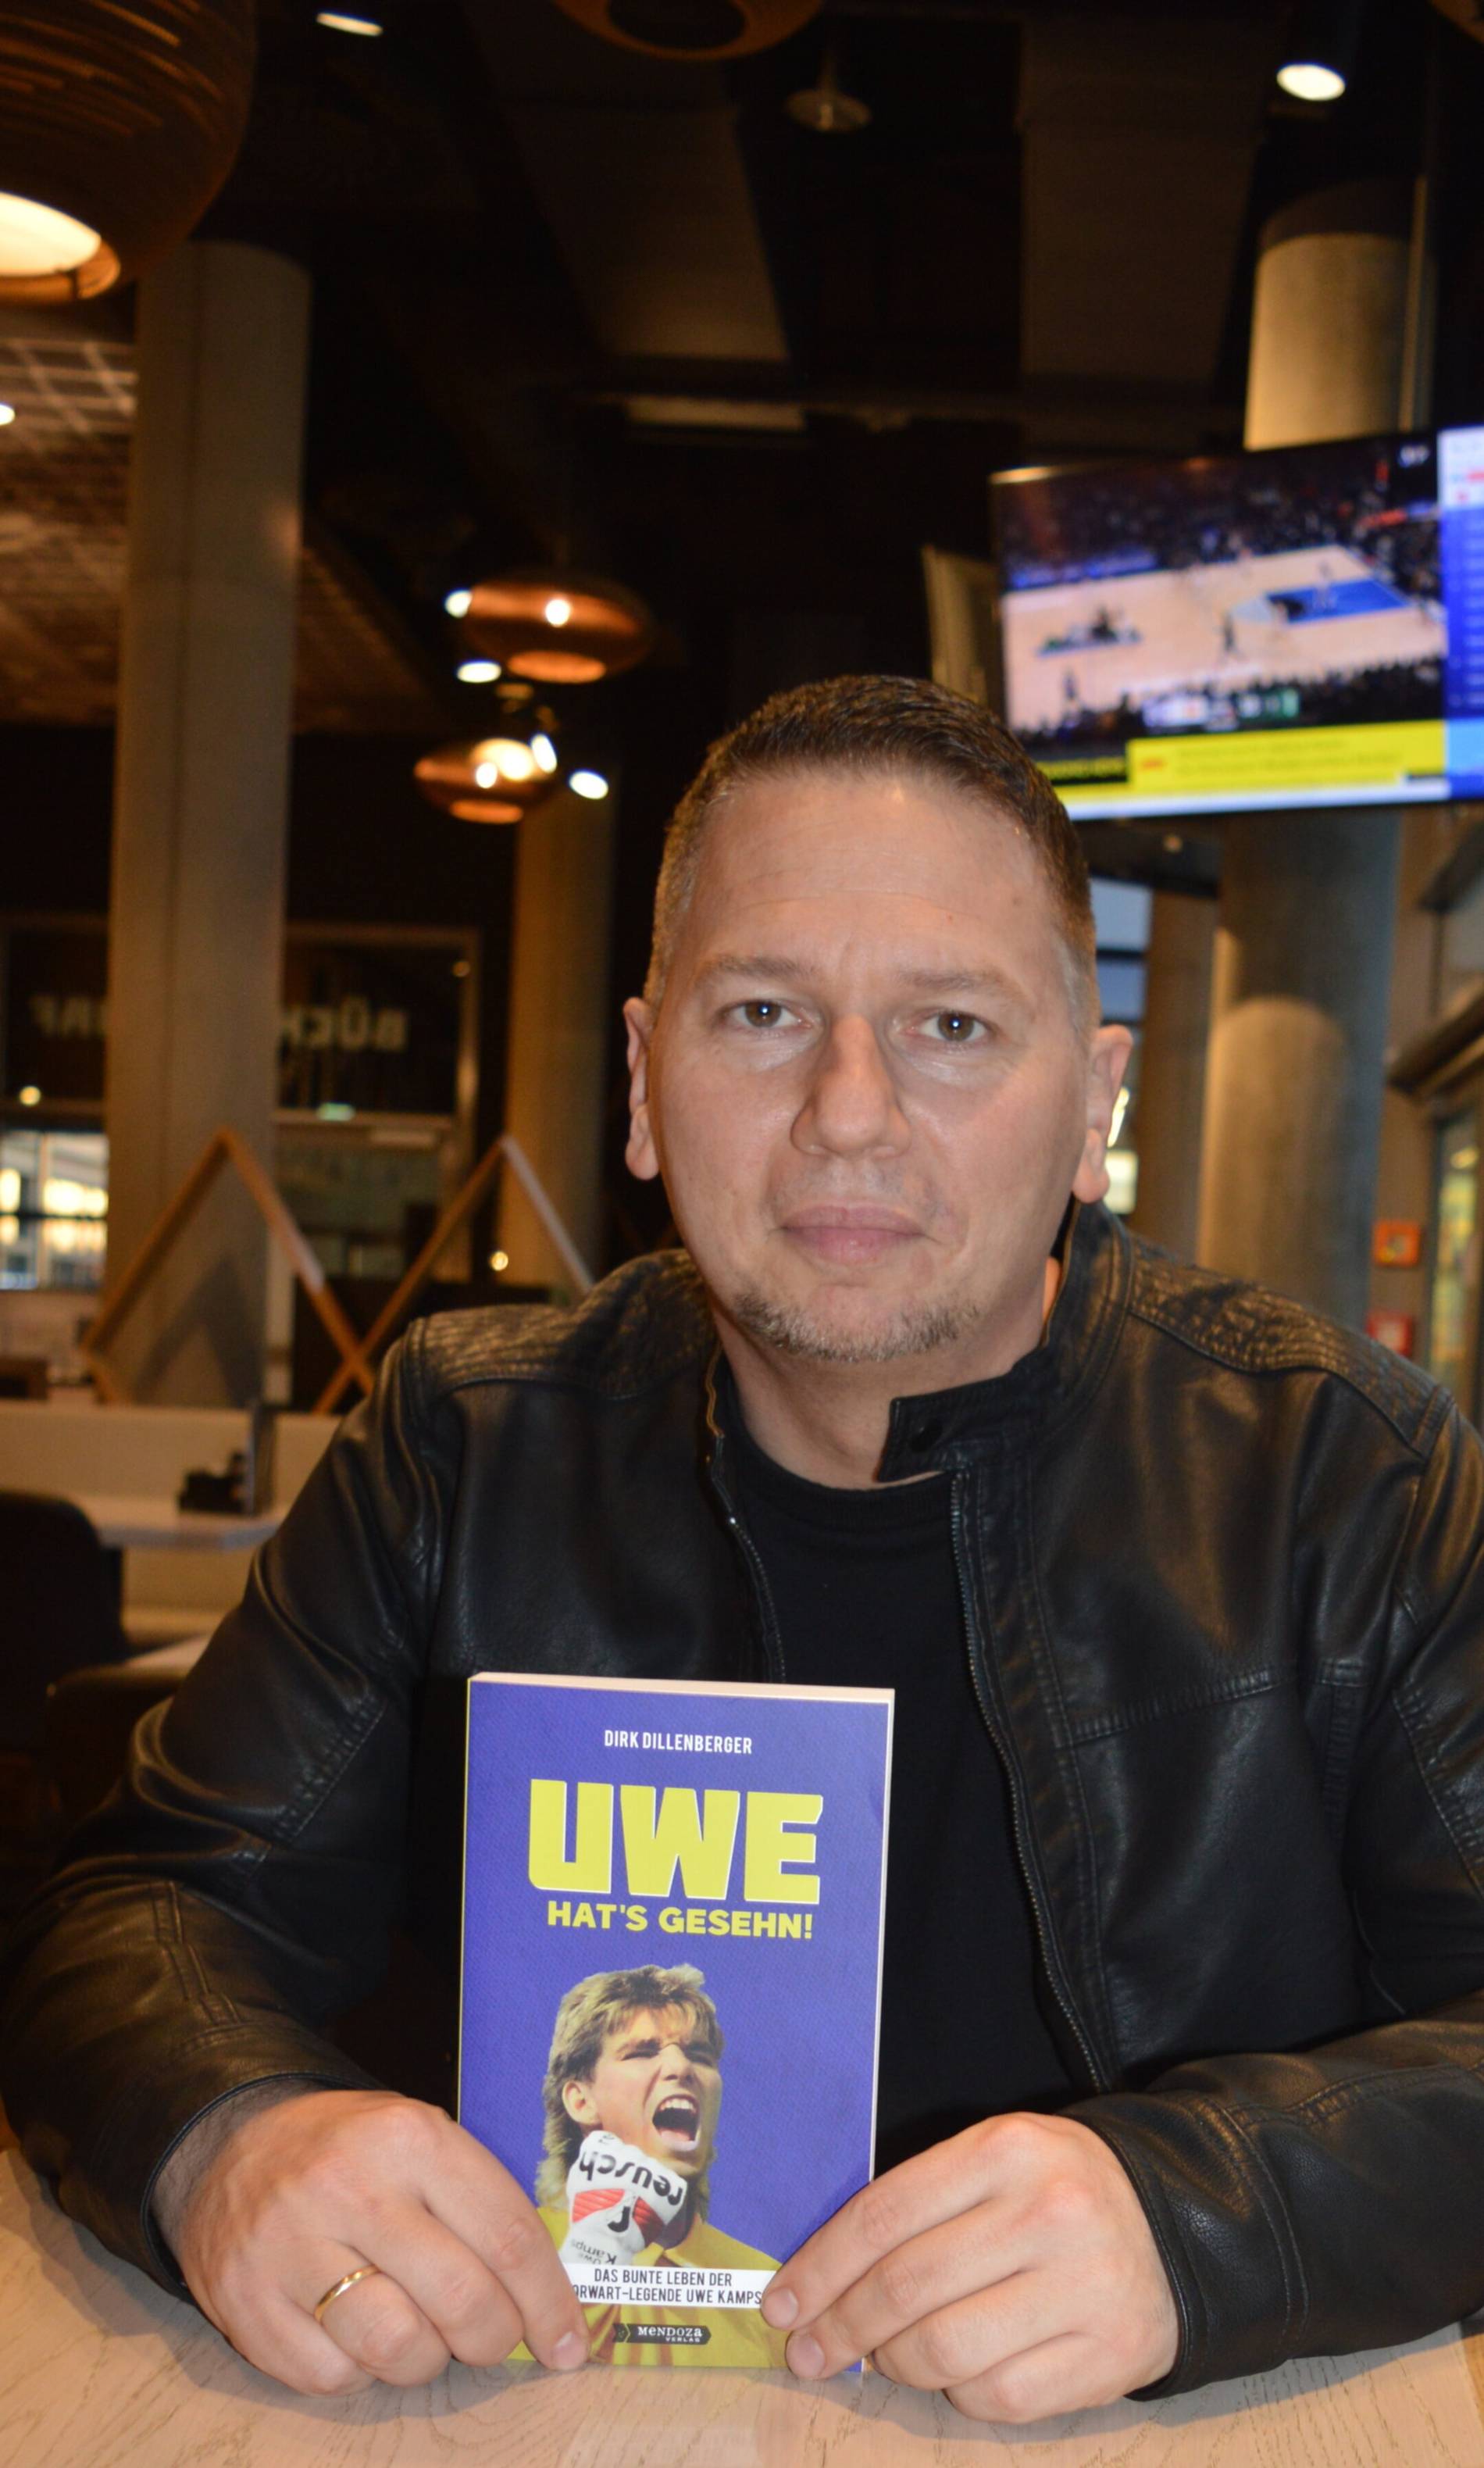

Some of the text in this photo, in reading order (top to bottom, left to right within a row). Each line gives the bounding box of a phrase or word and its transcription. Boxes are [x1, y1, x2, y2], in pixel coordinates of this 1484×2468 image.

[605, 1730, 752, 1755] DIRK DILLENBERGER
[528, 1778, 824, 1905] UWE
[547, 1900, 813, 1939] HAT'S GESEHN!
[579, 2151, 684, 2205] reusch
[594, 2268, 732, 2287] DAS BUNTE LEBEN DER
[573, 2284, 762, 2305] ORWART-LEGENDE UWE KAMPS
